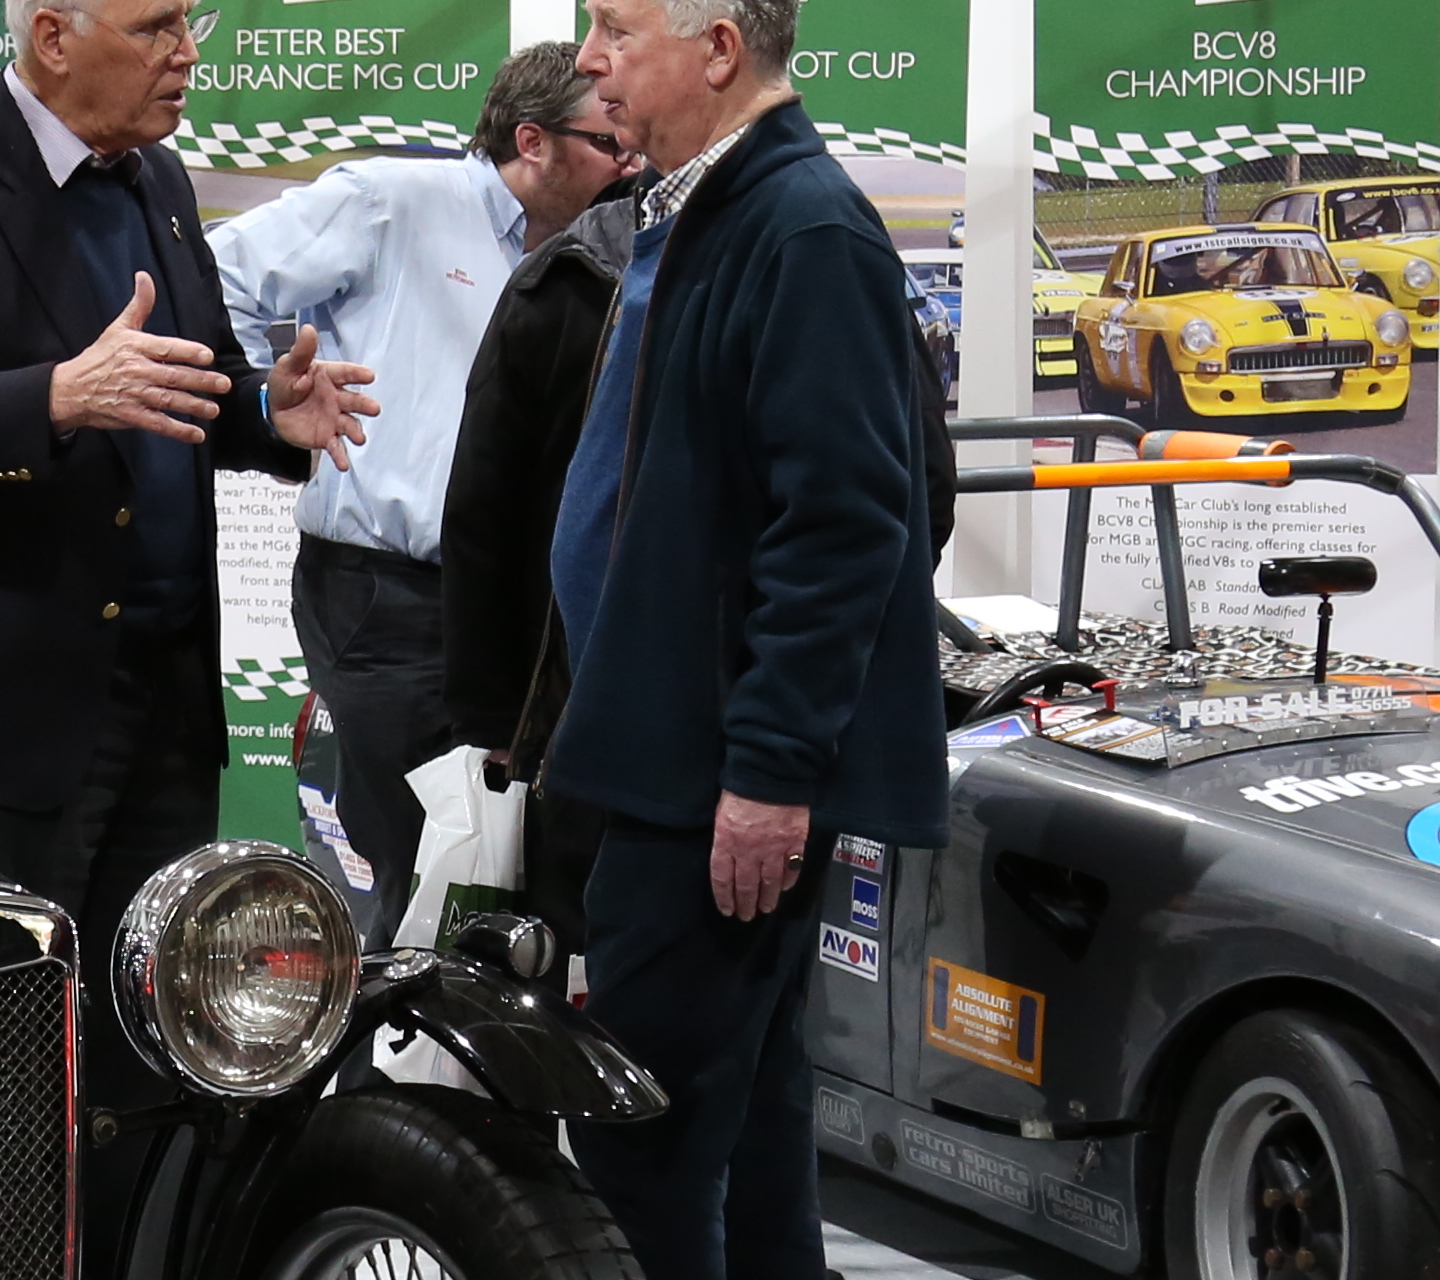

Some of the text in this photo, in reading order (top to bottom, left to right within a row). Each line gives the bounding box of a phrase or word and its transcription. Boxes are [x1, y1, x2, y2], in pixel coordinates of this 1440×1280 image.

[236, 28, 405, 56] PETER BEST
[1192, 30, 1277, 62] BCV8
[848, 50, 916, 79] CUP
[353, 63, 403, 91] MG
[413, 63, 479, 91] CUP
[1105, 67, 1366, 100] CHAMPIONSHIP
[223, 487, 297, 502] war T-Types
[239, 504, 277, 518] MGBs,
[1116, 497, 1347, 515] The Car Club's long established
[253, 523, 275, 535] and
[1096, 514, 1366, 535] BCV8 the premier series
[239, 540, 291, 552] the MG6
[1109, 534, 1377, 554] MGB racing, offering classes for
[219, 556, 272, 571] modified,
[1100, 552, 1236, 568] the fully V8s
[239, 574, 268, 587] front
[1215, 580, 1262, 594] Standar
[223, 596, 252, 608] want
[1218, 601, 1306, 618] Road Modified
[247, 613, 288, 629] helping
[1351, 685, 1393, 699] 07711
[1179, 685, 1349, 730] FOR SALE
[226, 725, 266, 738] more
[822, 929, 877, 966] AVON
[955, 982, 1013, 1013] ABSOLUTE
[951, 998, 1015, 1030] ALIGNMENT
[903, 1125, 1031, 1184] retro sports
[908, 1146, 1030, 1208] cars limited
